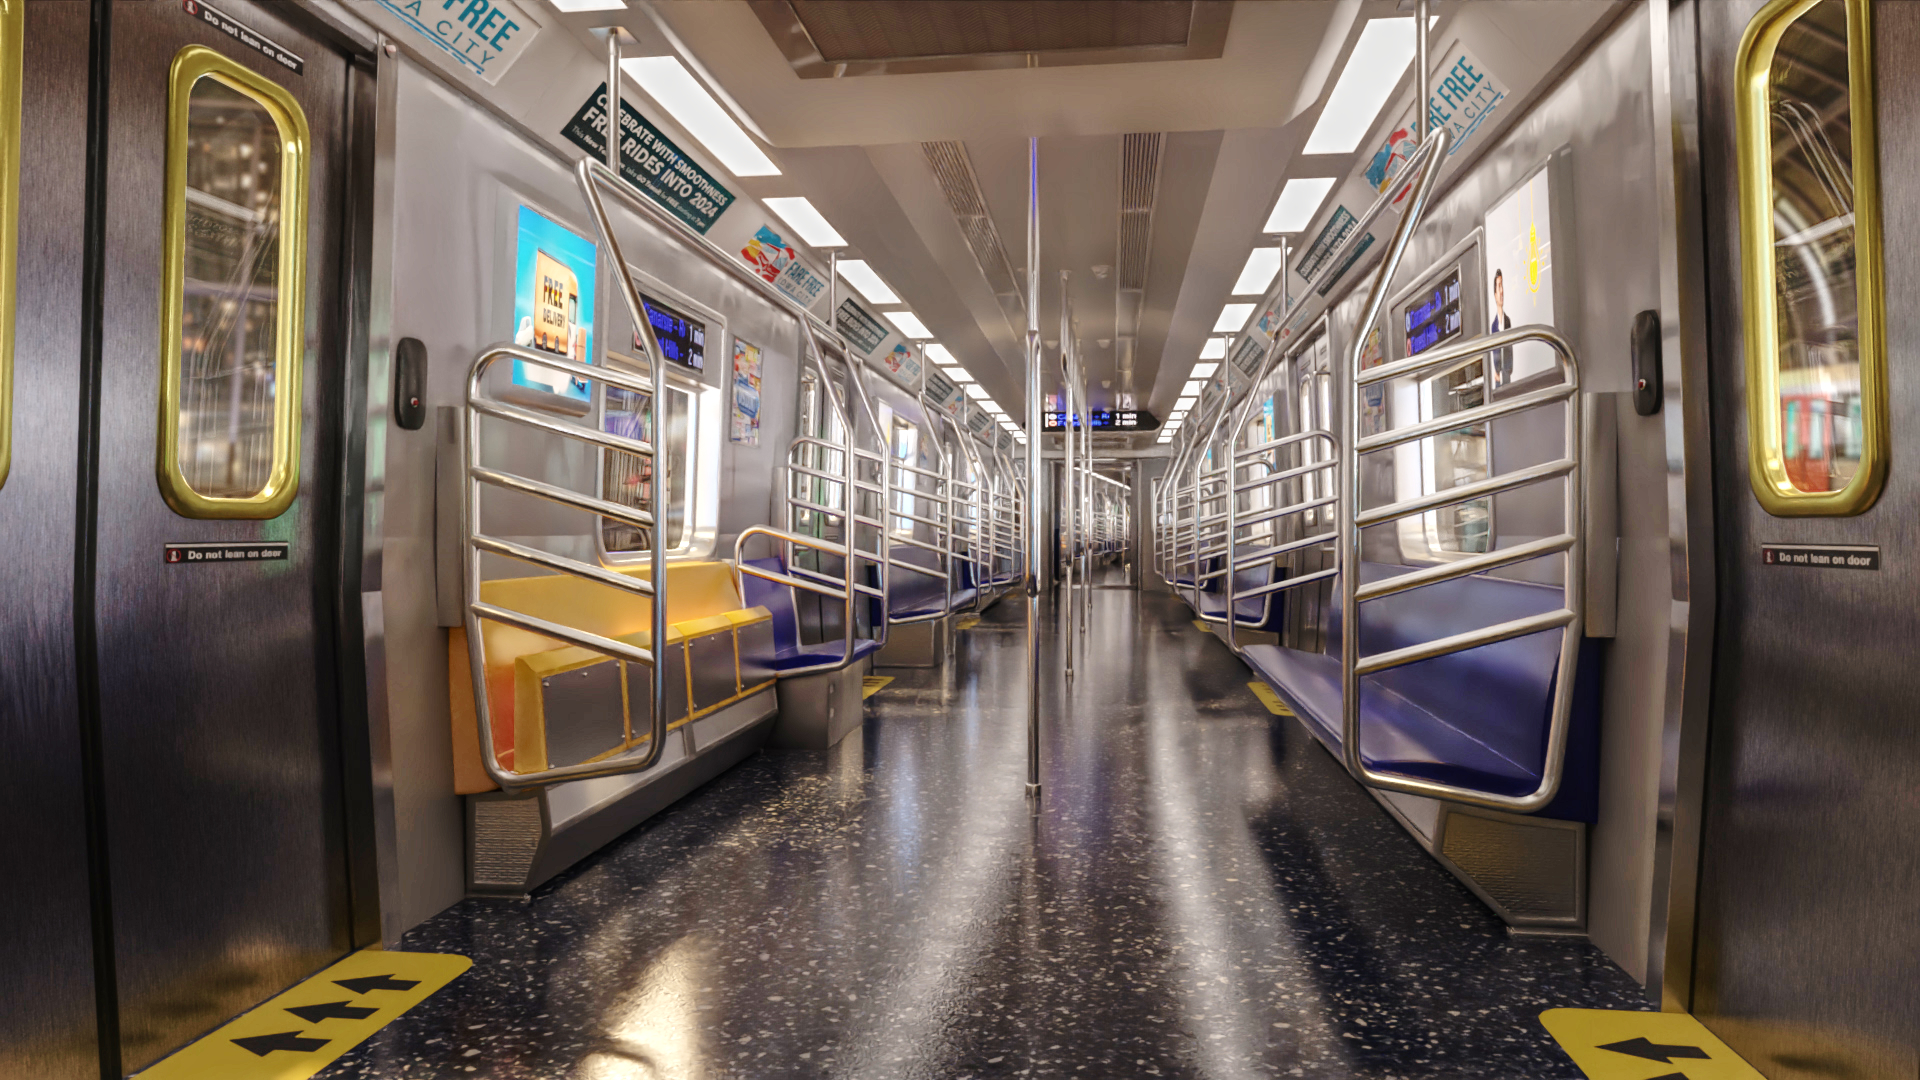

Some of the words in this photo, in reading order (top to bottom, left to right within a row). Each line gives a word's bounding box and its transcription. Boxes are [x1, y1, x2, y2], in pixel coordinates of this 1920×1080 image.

[204, 10, 219, 26] Do
[221, 22, 238, 37] not
[240, 31, 261, 50] lean
[262, 45, 275, 57] on
[276, 53, 298, 70] door
[436, 20, 495, 65] CITY
[1436, 55, 1484, 110] FREE
[1463, 81, 1496, 119] CITY
[596, 93, 655, 146] CEBRATE
[651, 138, 678, 165] WITH
[674, 159, 729, 206] SMOOTHNESS
[621, 137, 665, 176] RIDES
[660, 168, 693, 198] INTO
[688, 192, 720, 219] 2024
[543, 275, 564, 310] FREE
[784, 261, 810, 286] FARE
[801, 275, 825, 298] FREE
[542, 308, 567, 330] DELIVERY
[187, 550, 203, 560] Do
[205, 549, 222, 559] not
[225, 549, 245, 559] lean
[247, 550, 259, 558] on
[261, 549, 282, 558] door
[1779, 552, 1791, 562] Do
[1793, 553, 1809, 563] not
[1810, 553, 1830, 564] lean
[1832, 555, 1845, 565] on
[1847, 554, 1871, 566] door
